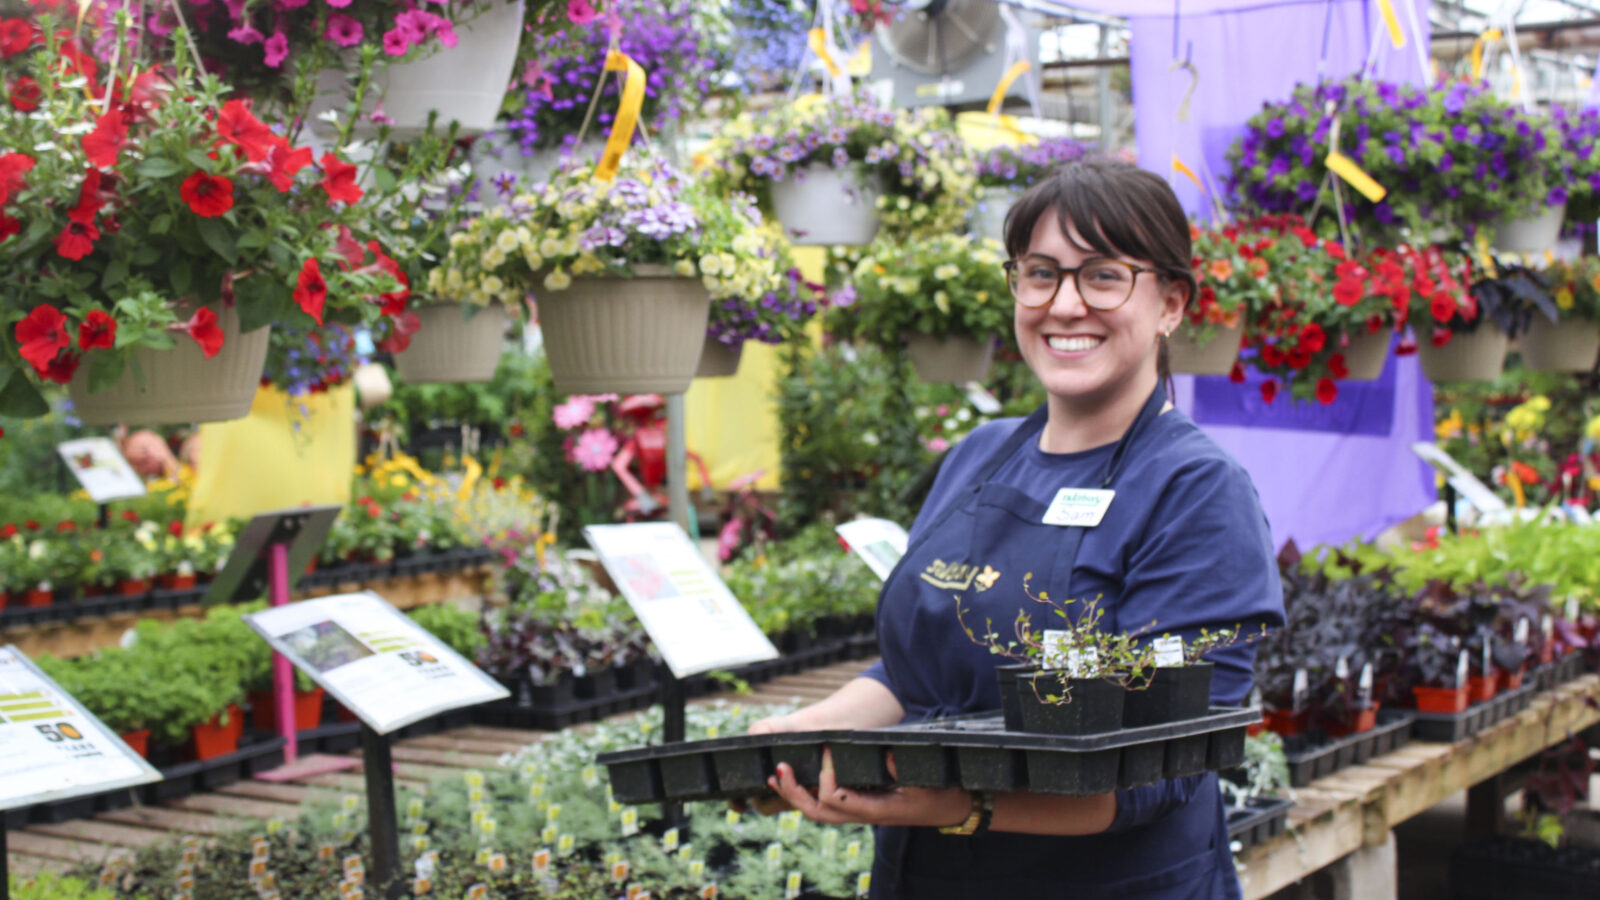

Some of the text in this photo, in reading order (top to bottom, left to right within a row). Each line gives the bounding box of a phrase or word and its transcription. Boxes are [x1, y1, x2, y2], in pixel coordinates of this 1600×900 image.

[1056, 508, 1096, 521] Sam
[397, 650, 439, 667] 50
[34, 721, 84, 742] 50
